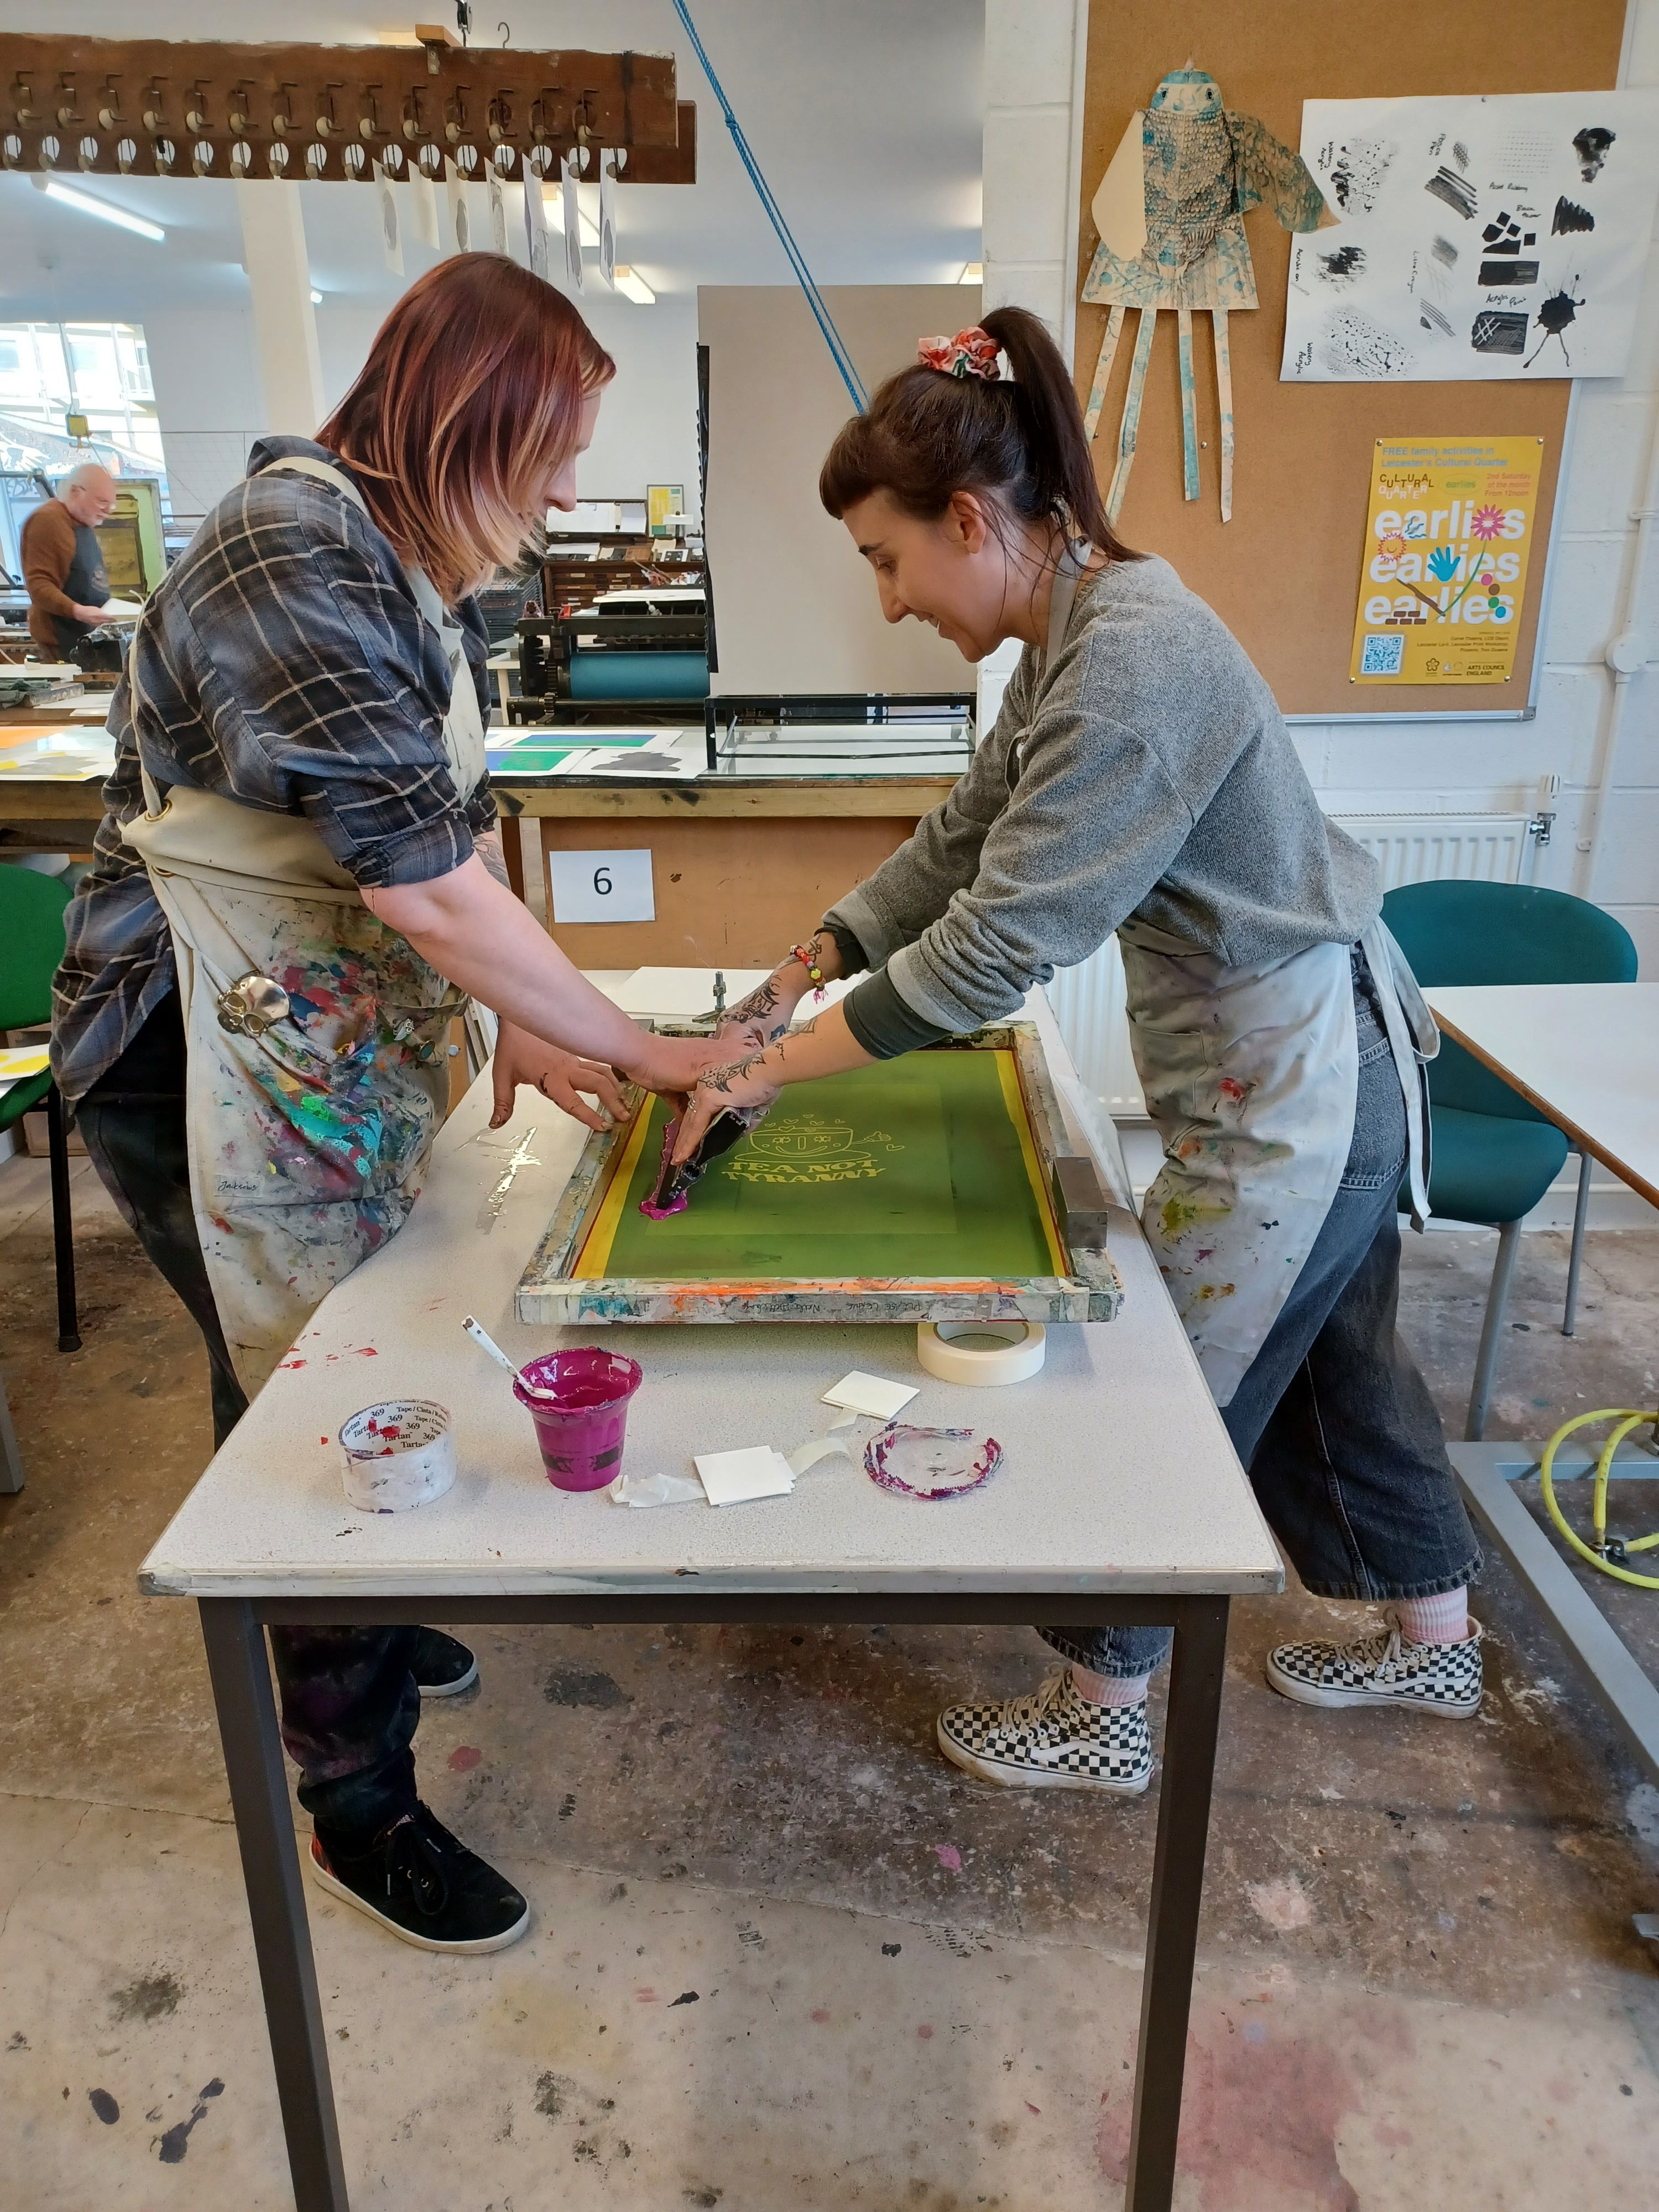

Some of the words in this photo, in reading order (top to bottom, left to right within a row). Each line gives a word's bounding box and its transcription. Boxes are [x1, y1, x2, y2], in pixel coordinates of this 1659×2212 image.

[1295, 351, 1306, 374] Acrylic
[1383, 447, 1407, 455] FREE
[1411, 447, 1438, 457] family
[1436, 458, 1471, 467] Cultural
[1475, 458, 1508, 467] Quarter
[1379, 473, 1434, 488] CULTURAL
[1378, 485, 1427, 499] QUARTER
[1375, 500, 1525, 540] earlis
[594, 867, 612, 895] 6
[728, 1162, 799, 1174] TEA
[807, 1159, 878, 1173] NOT
[721, 1168, 886, 1183] TYRANNY
[370, 1408, 384, 1417] 369
[416, 1406, 431, 1415] Cinta
[388, 1415, 403, 1423] 369
[423, 1432, 435, 1441] 369
